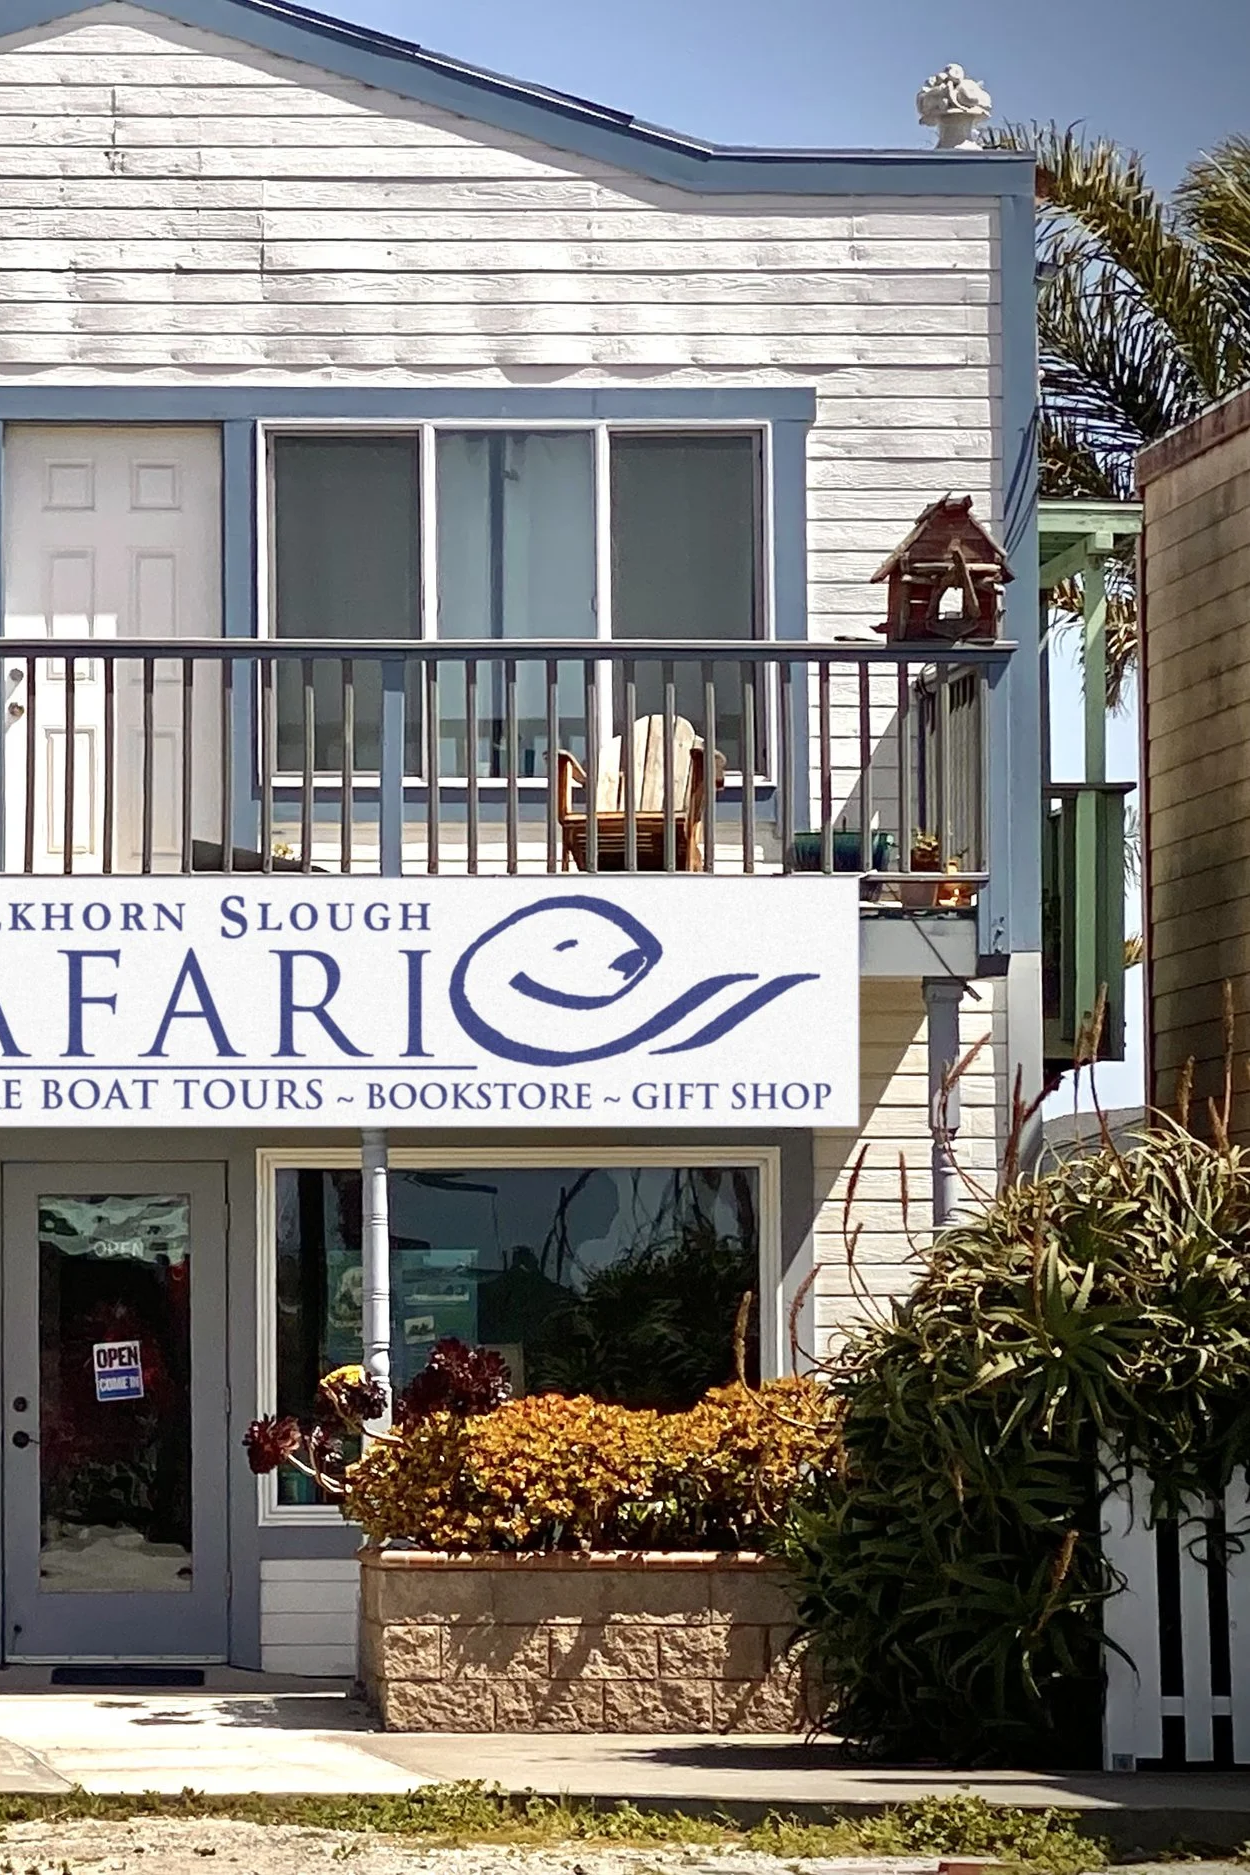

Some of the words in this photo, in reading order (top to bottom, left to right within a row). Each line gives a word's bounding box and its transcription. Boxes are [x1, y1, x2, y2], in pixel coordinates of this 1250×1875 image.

[220, 895, 432, 940] SLOUGH
[41, 1079, 159, 1111] BOAT
[173, 1079, 324, 1111] TOURS
[366, 1082, 592, 1111] BOOKSTORE
[632, 1082, 720, 1111] GIFT
[731, 1082, 832, 1111] SHOP
[94, 1239, 144, 1257] OPEN
[96, 1346, 139, 1369] OPEN
